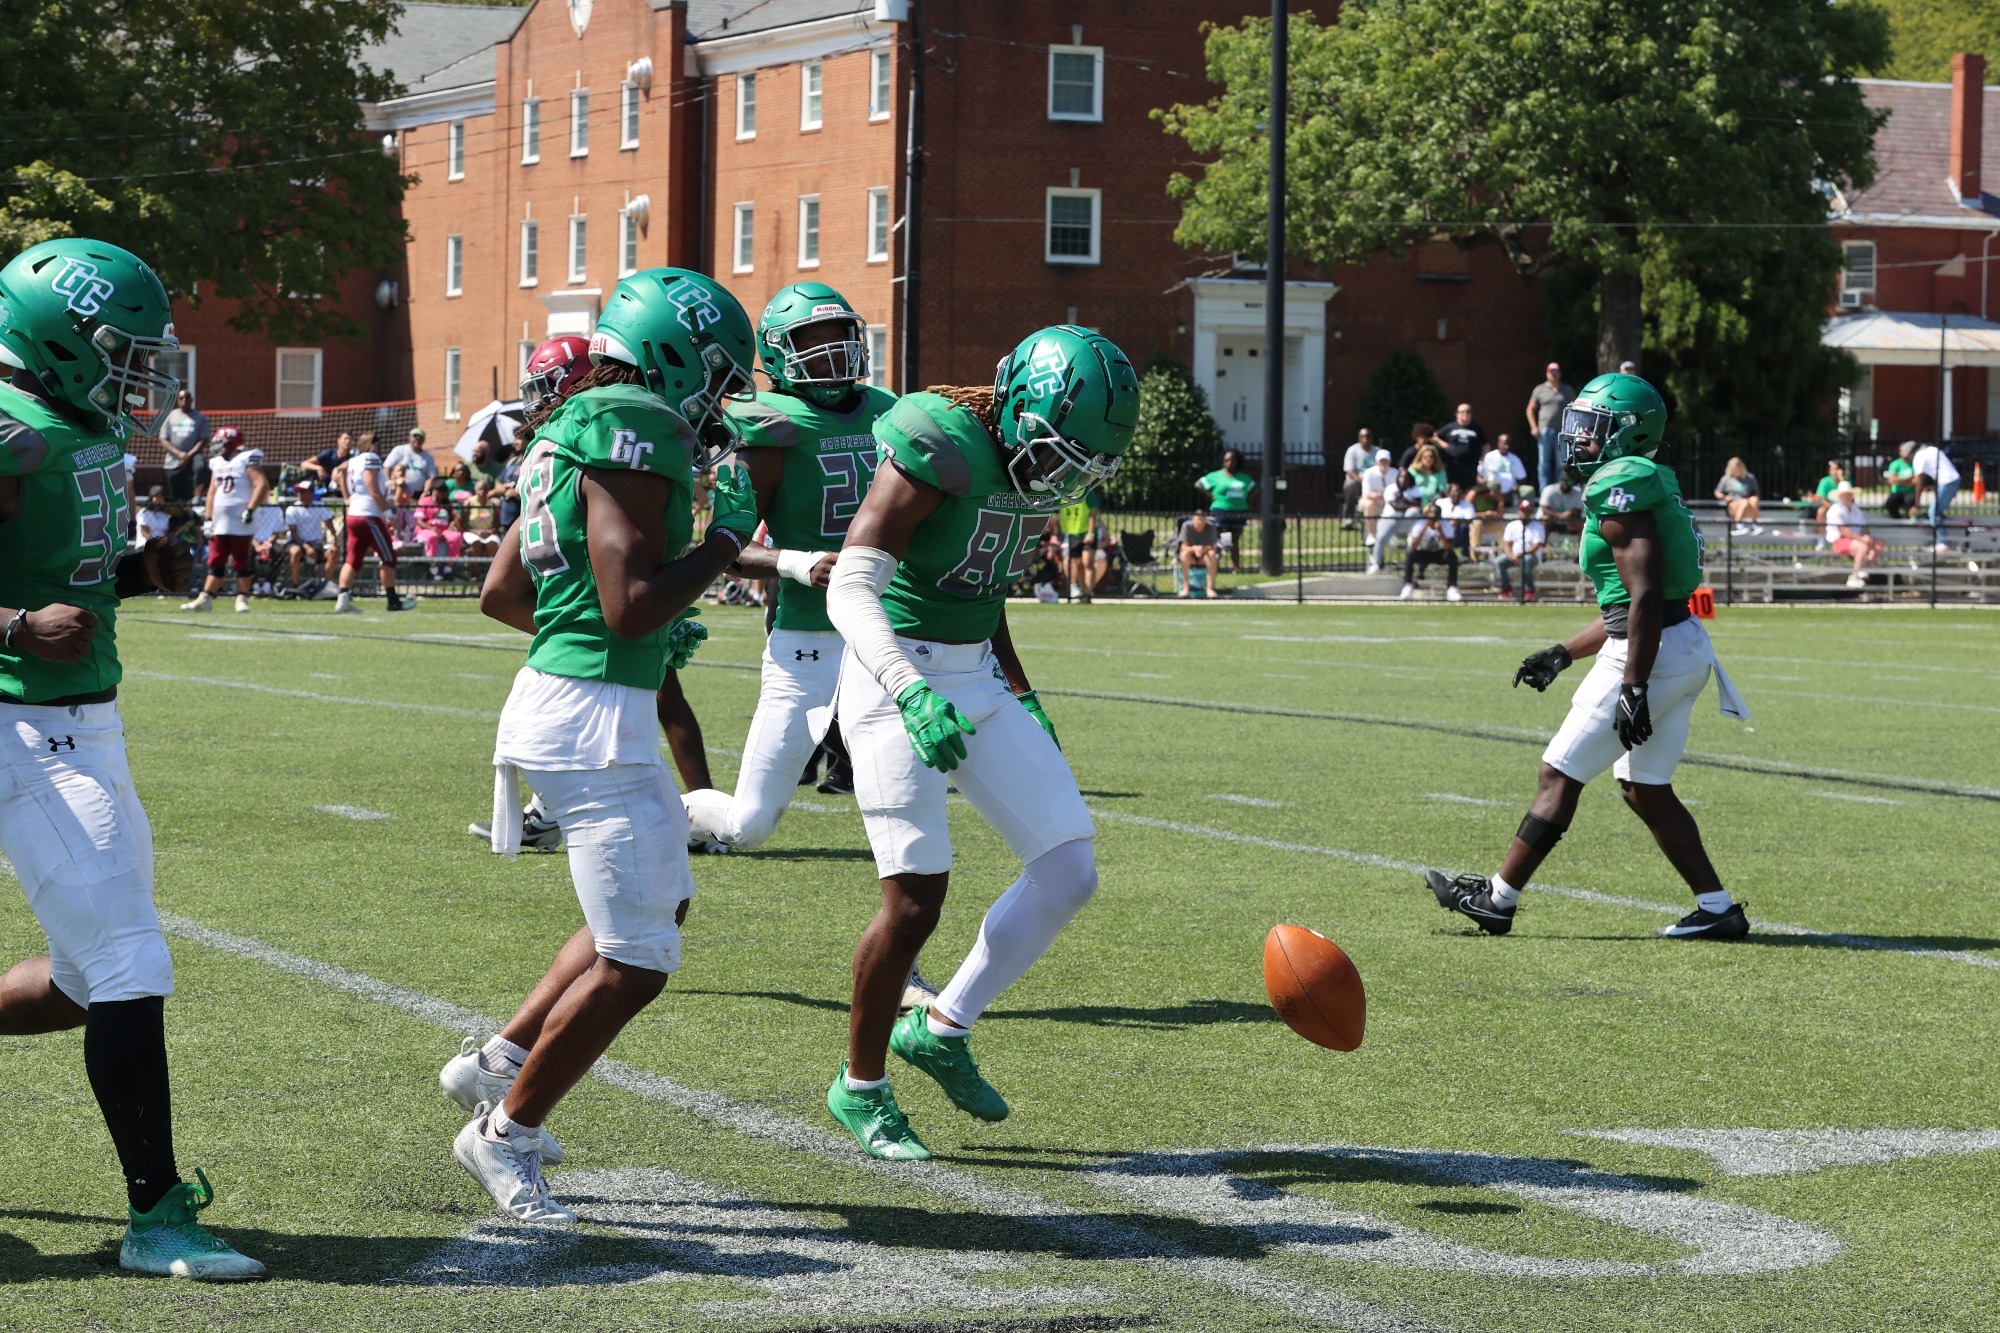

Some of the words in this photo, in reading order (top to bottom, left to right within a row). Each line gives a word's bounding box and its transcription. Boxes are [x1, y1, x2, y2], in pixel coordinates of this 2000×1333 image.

[51, 255, 114, 316] GC
[609, 428, 654, 471] GC
[1608, 487, 1635, 512] GC
